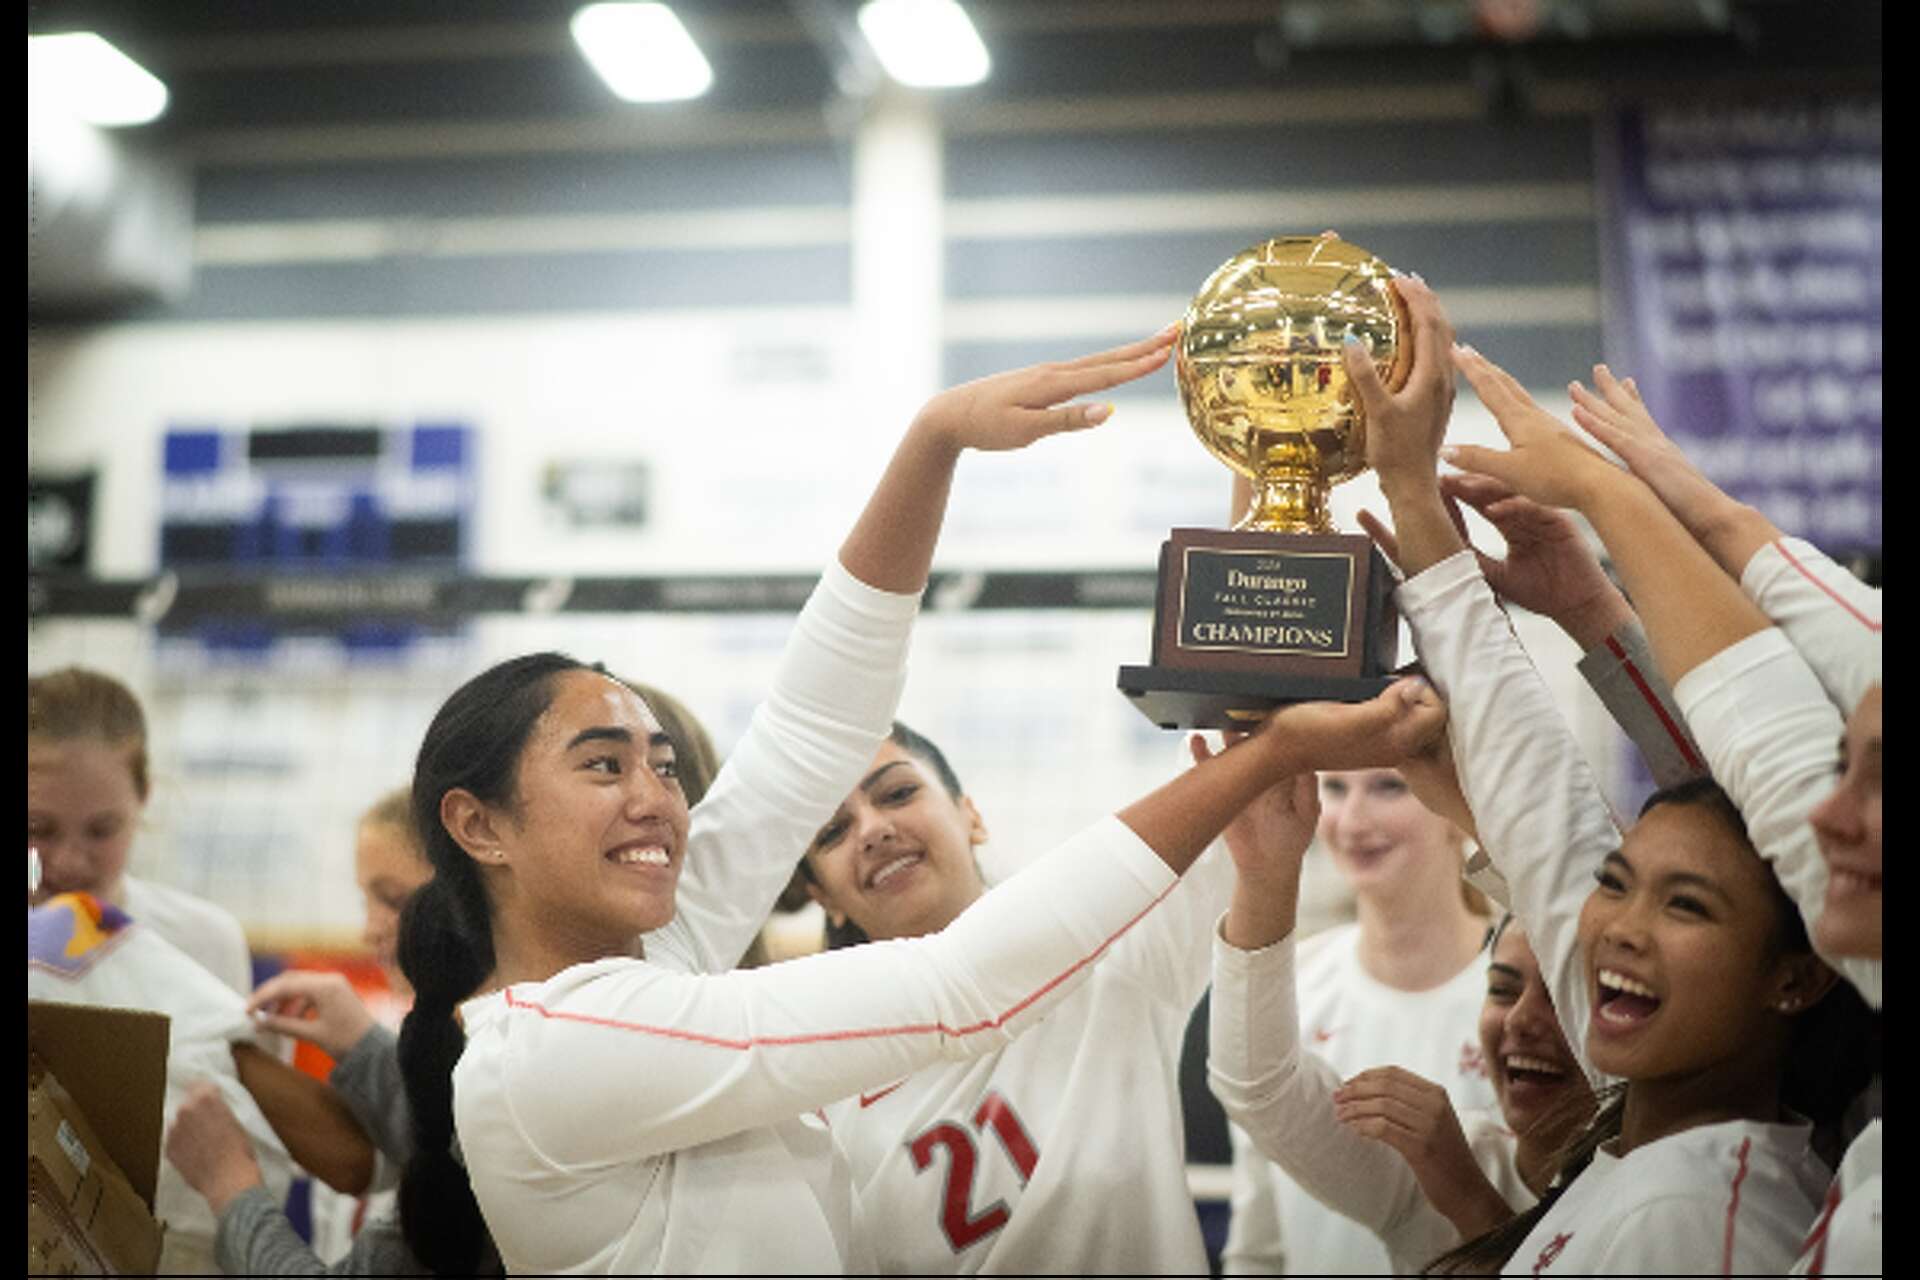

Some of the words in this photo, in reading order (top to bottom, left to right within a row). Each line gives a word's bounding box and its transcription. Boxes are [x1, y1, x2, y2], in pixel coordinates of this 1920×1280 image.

[1227, 569, 1308, 593] Durango
[1215, 592, 1248, 605] FALL
[1253, 594, 1317, 608] CLASSIC
[1192, 622, 1334, 647] CHAMPIONS
[904, 1089, 1041, 1254] 21
